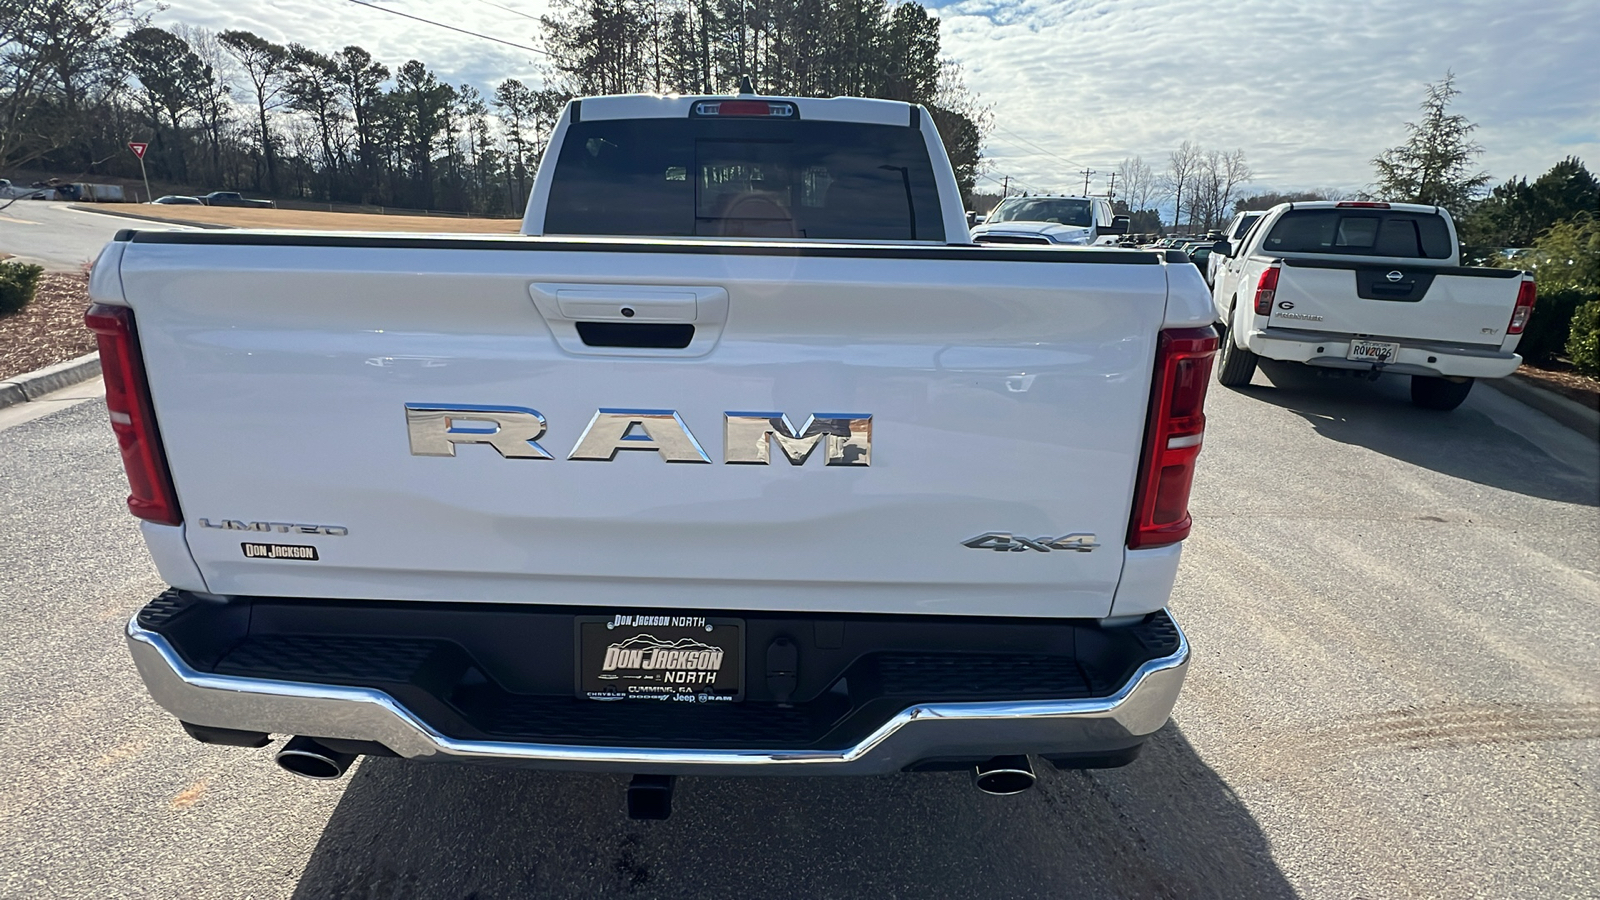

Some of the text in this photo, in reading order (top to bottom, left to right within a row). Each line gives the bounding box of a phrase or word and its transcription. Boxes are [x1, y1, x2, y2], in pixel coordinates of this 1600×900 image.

[1275, 311, 1323, 322] FRONTIER
[404, 402, 873, 467] RAM
[198, 517, 349, 536] LIMITED
[245, 543, 313, 558] DON JACKSON
[614, 614, 706, 628] DON JACKSON NORTH
[602, 647, 724, 671] DON JACKSON
[663, 671, 717, 684] NORTH
[672, 693, 696, 703] Jeep
